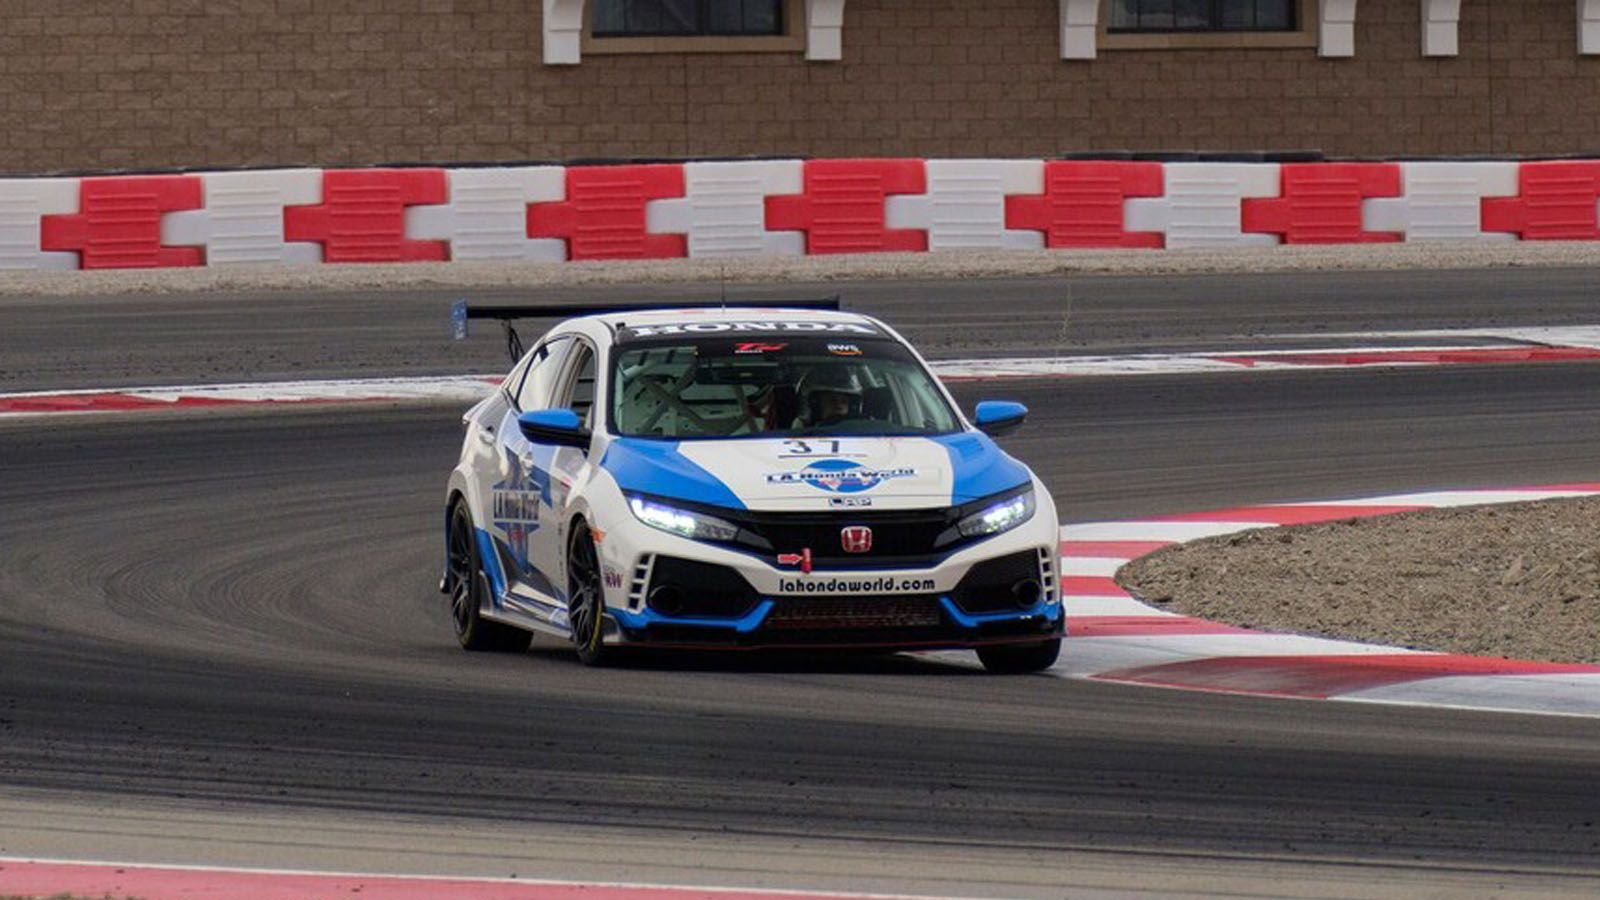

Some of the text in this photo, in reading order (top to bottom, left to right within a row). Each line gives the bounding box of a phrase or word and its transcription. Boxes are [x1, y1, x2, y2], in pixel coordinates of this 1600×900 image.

[633, 321, 877, 337] HONDA
[783, 440, 840, 454] 37
[800, 471, 857, 480] Honda
[860, 468, 915, 479] World
[779, 578, 936, 593] lahondaworld.com
